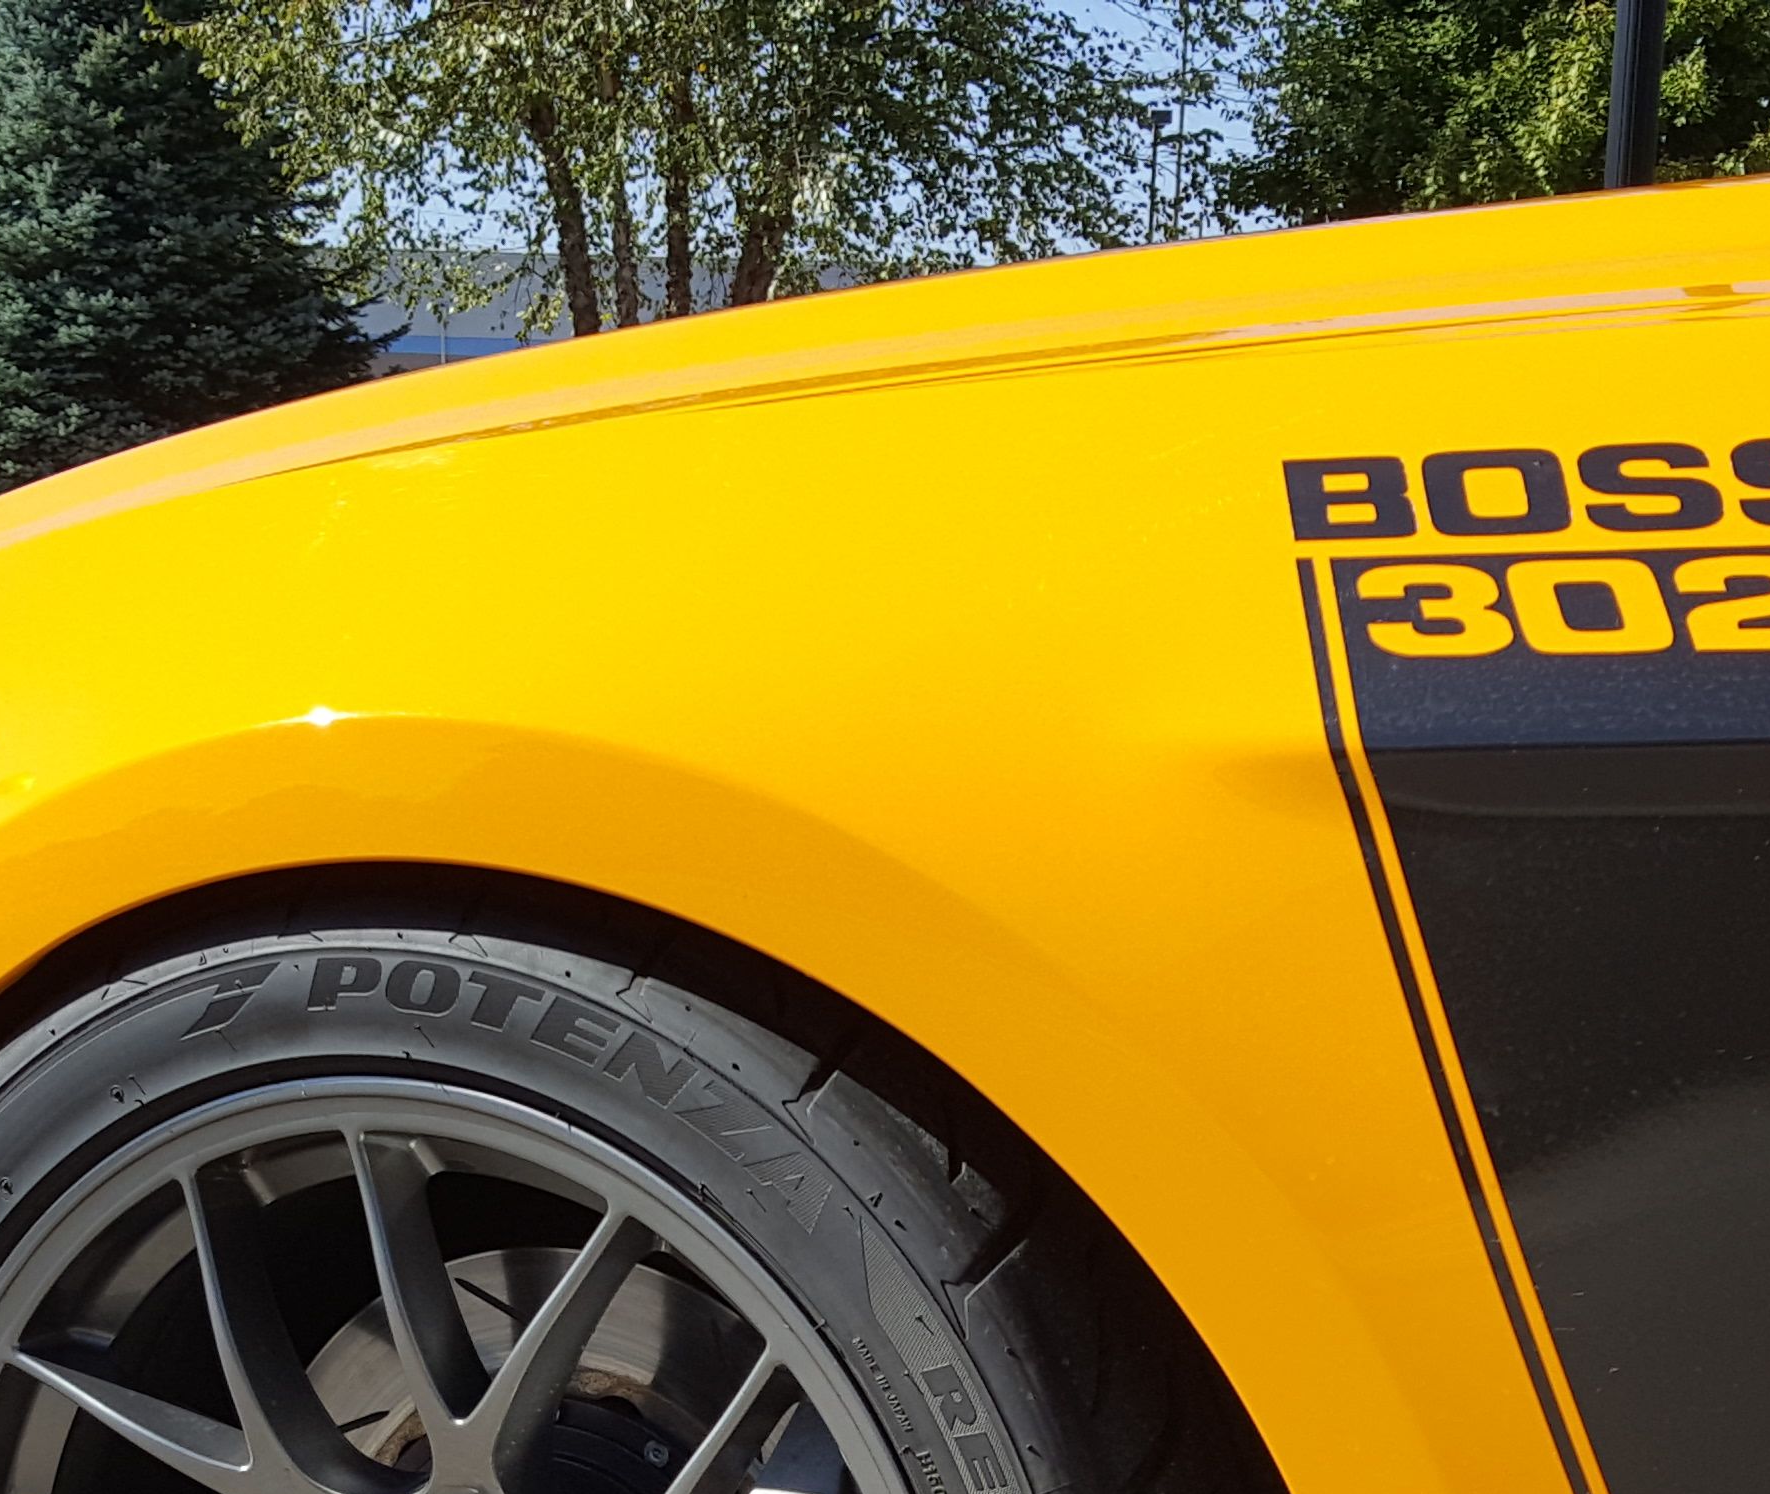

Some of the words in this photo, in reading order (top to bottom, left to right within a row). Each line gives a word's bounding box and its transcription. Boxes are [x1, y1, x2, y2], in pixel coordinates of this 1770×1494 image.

[307, 957, 832, 1234] POTENZA
[851, 1335, 880, 1374] MADE
[875, 1373, 890, 1390] IN
[885, 1392, 914, 1434] JAPAN
